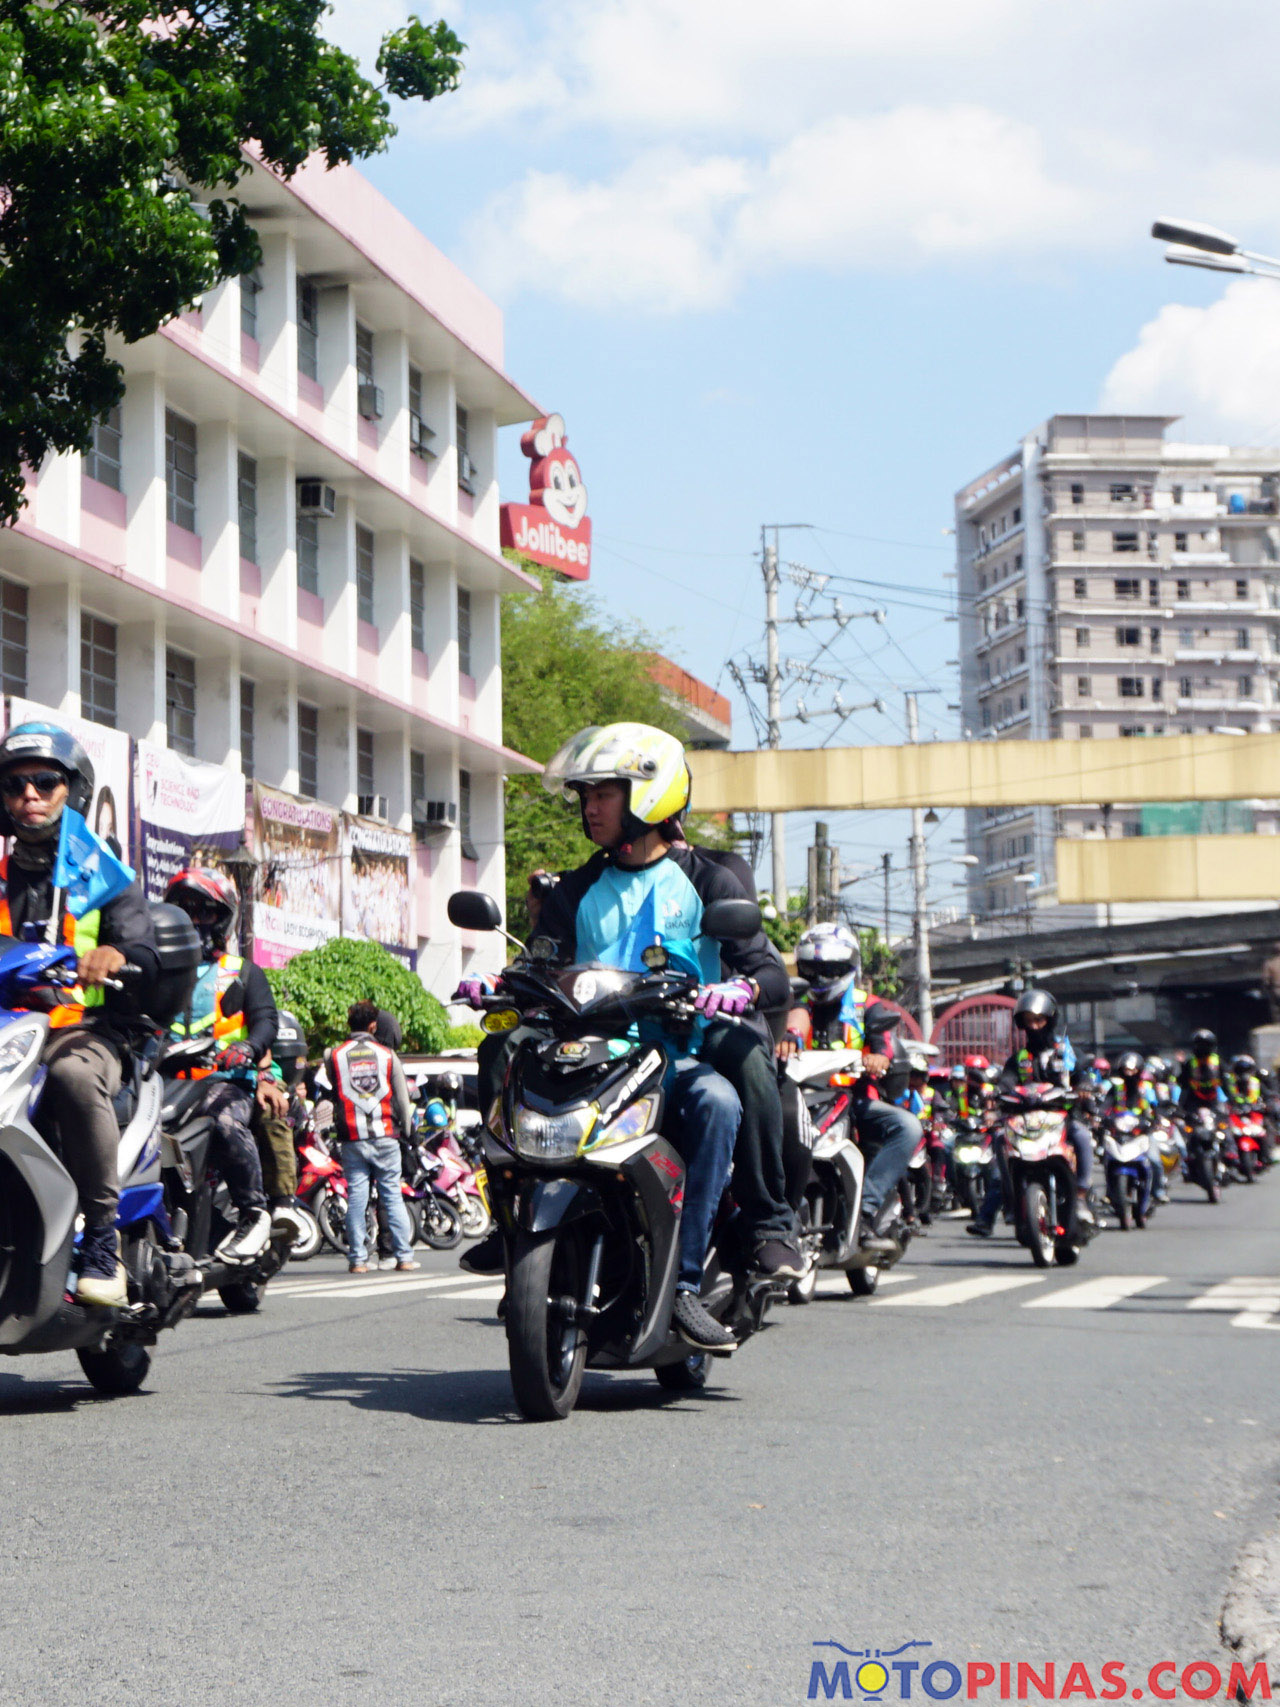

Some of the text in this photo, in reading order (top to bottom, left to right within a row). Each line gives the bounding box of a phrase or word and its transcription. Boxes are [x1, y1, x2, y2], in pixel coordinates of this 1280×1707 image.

[515, 516, 589, 566] Jollibee
[261, 797, 333, 831] CONGRATULATIONS
[648, 1150, 683, 1180] 125
